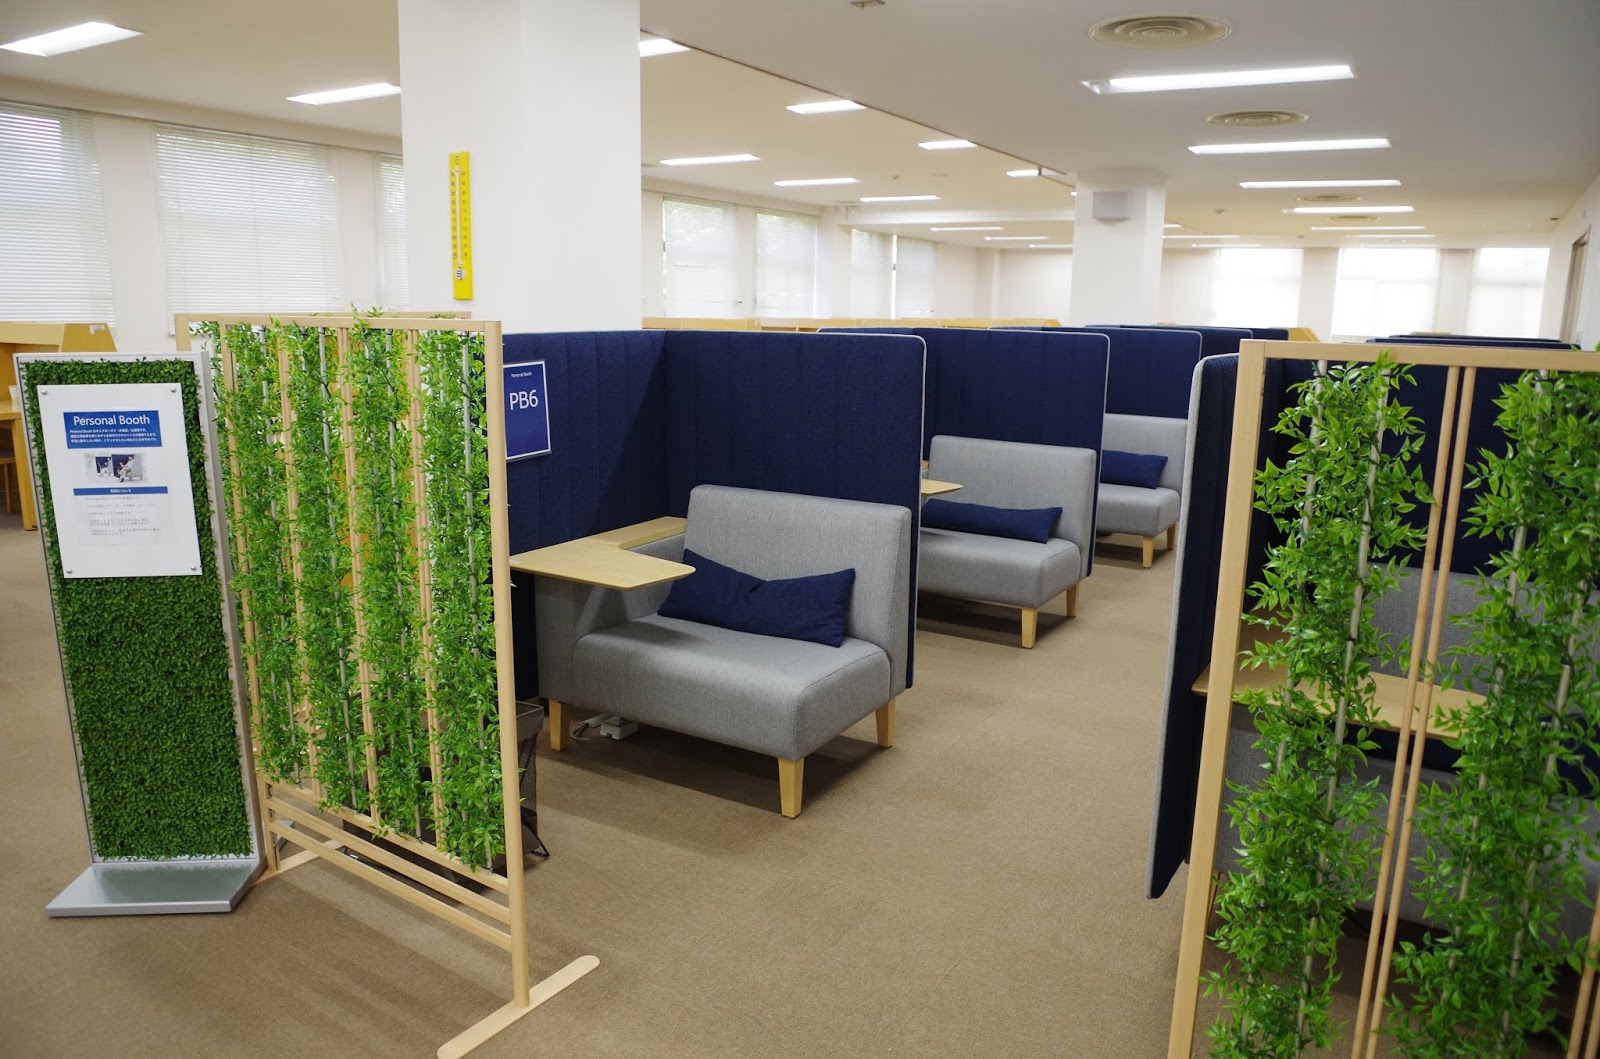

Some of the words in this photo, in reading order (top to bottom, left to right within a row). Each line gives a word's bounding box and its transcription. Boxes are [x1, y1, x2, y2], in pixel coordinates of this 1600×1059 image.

[509, 389, 539, 411] PB6
[73, 415, 117, 426] Personal
[119, 414, 150, 425] Booth
